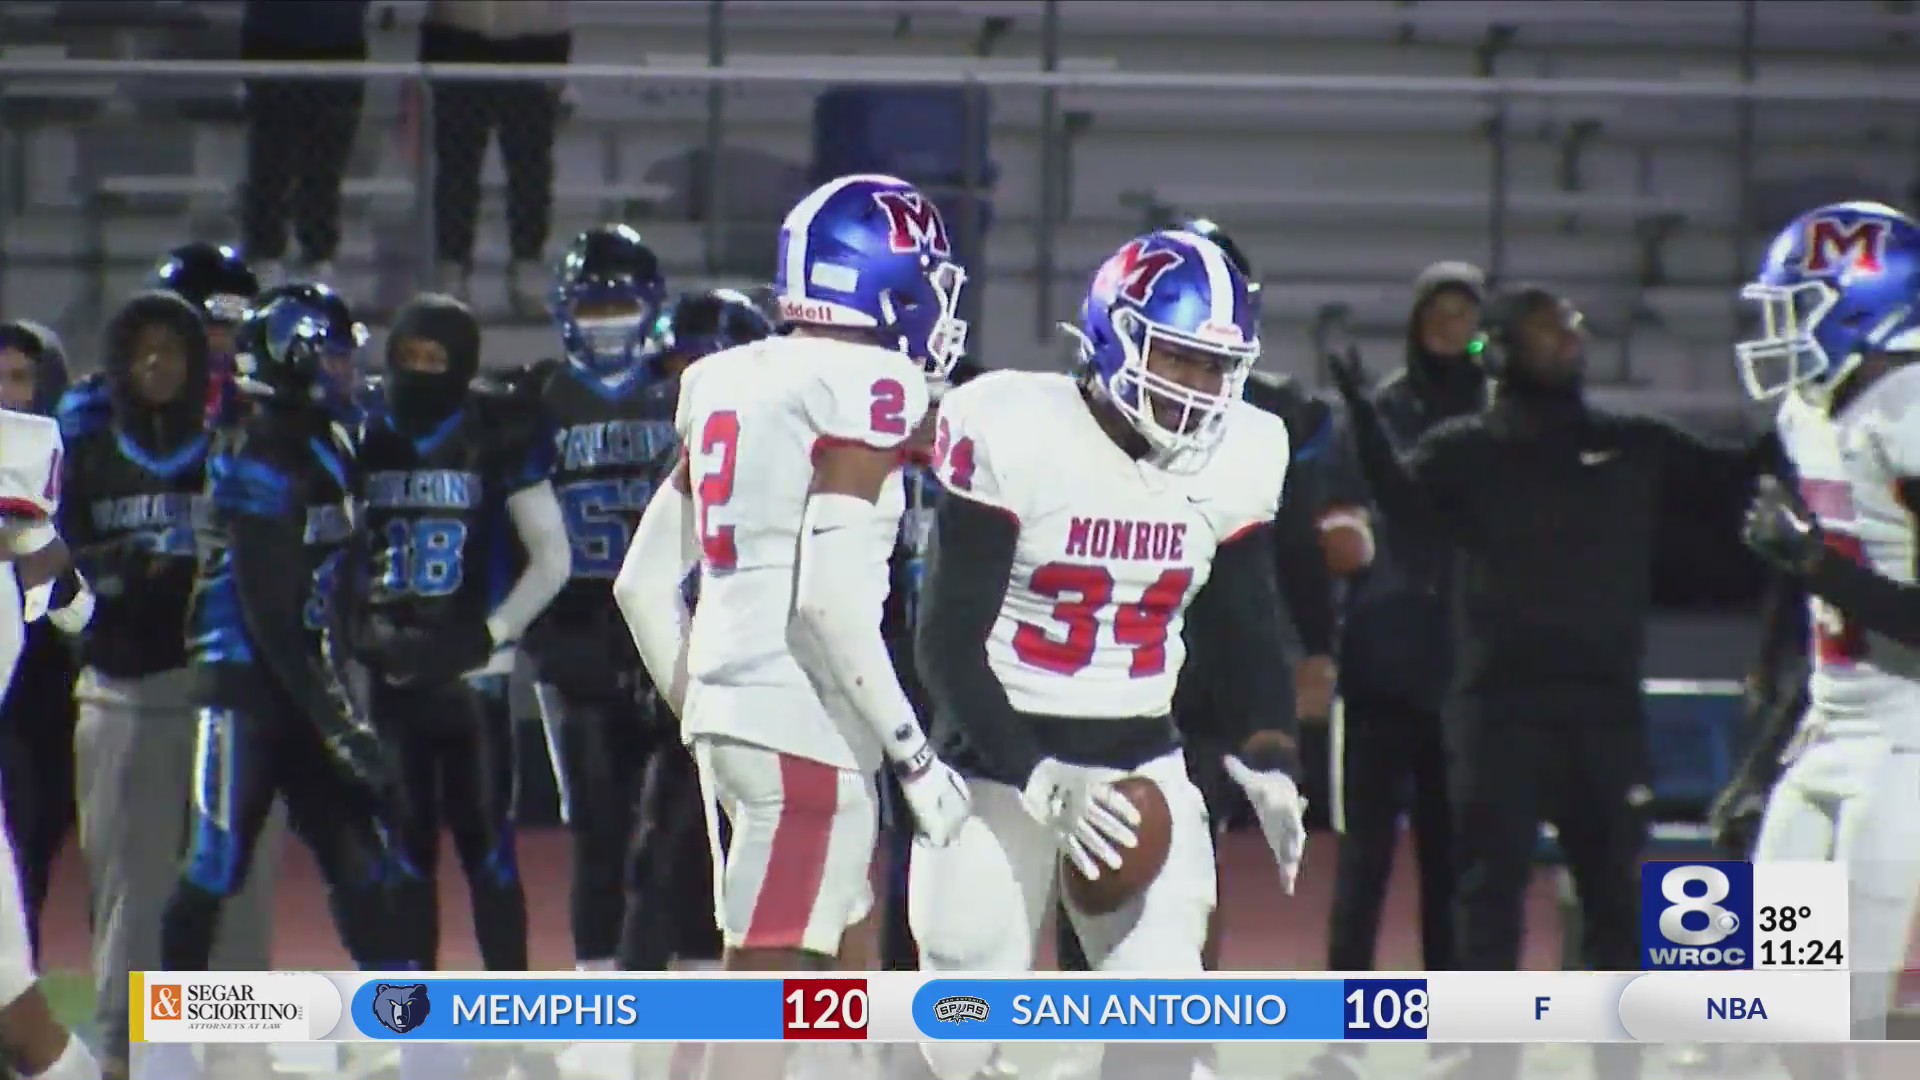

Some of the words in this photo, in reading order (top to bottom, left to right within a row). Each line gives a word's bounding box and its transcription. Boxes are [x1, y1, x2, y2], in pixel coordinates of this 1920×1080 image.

[872, 192, 951, 258] M
[1805, 217, 1892, 277] M
[870, 378, 906, 436] 2
[699, 410, 741, 570] 2
[385, 519, 468, 597] 18
[1065, 517, 1187, 561] MONROE
[1012, 561, 1194, 679] 34
